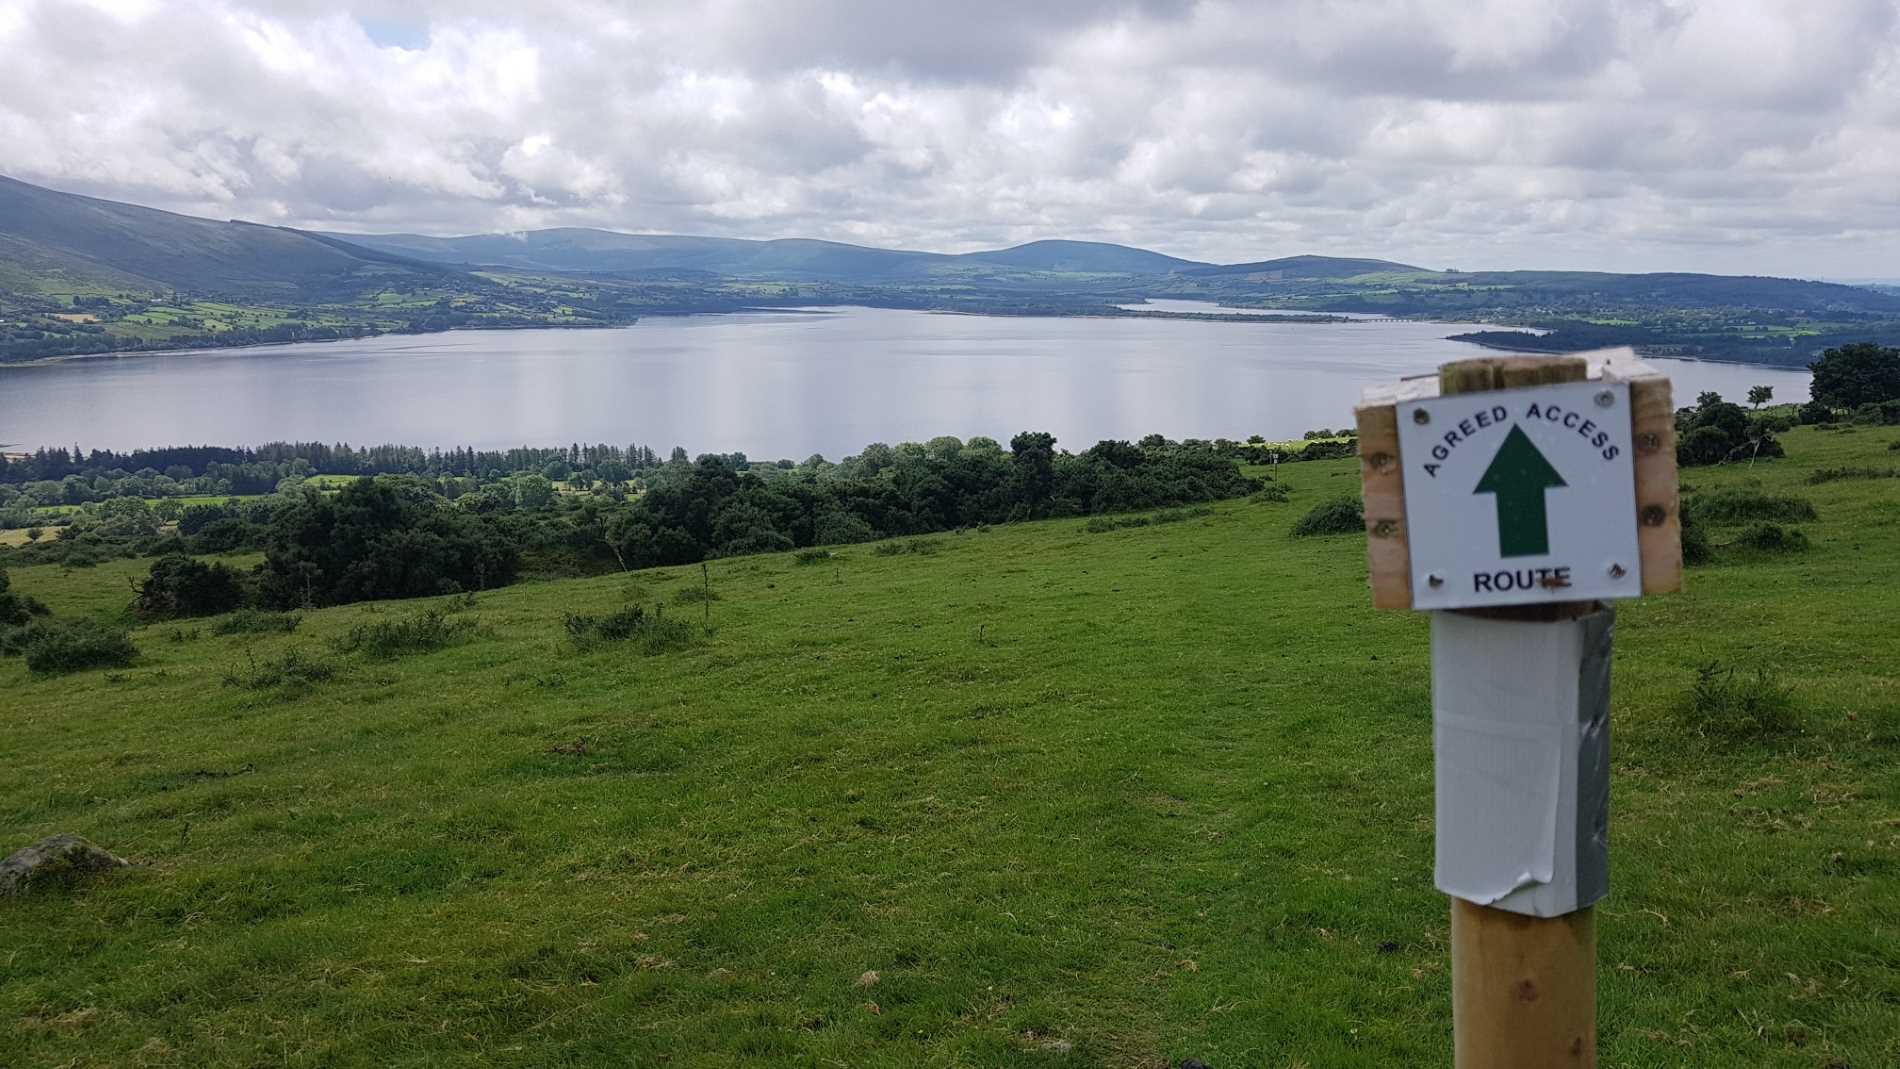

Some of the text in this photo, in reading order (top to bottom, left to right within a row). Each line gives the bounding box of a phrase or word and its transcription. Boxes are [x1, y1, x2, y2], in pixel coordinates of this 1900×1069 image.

[1423, 402, 1620, 478] AGREED ACCESS
[1473, 566, 1573, 593] ROUTE
